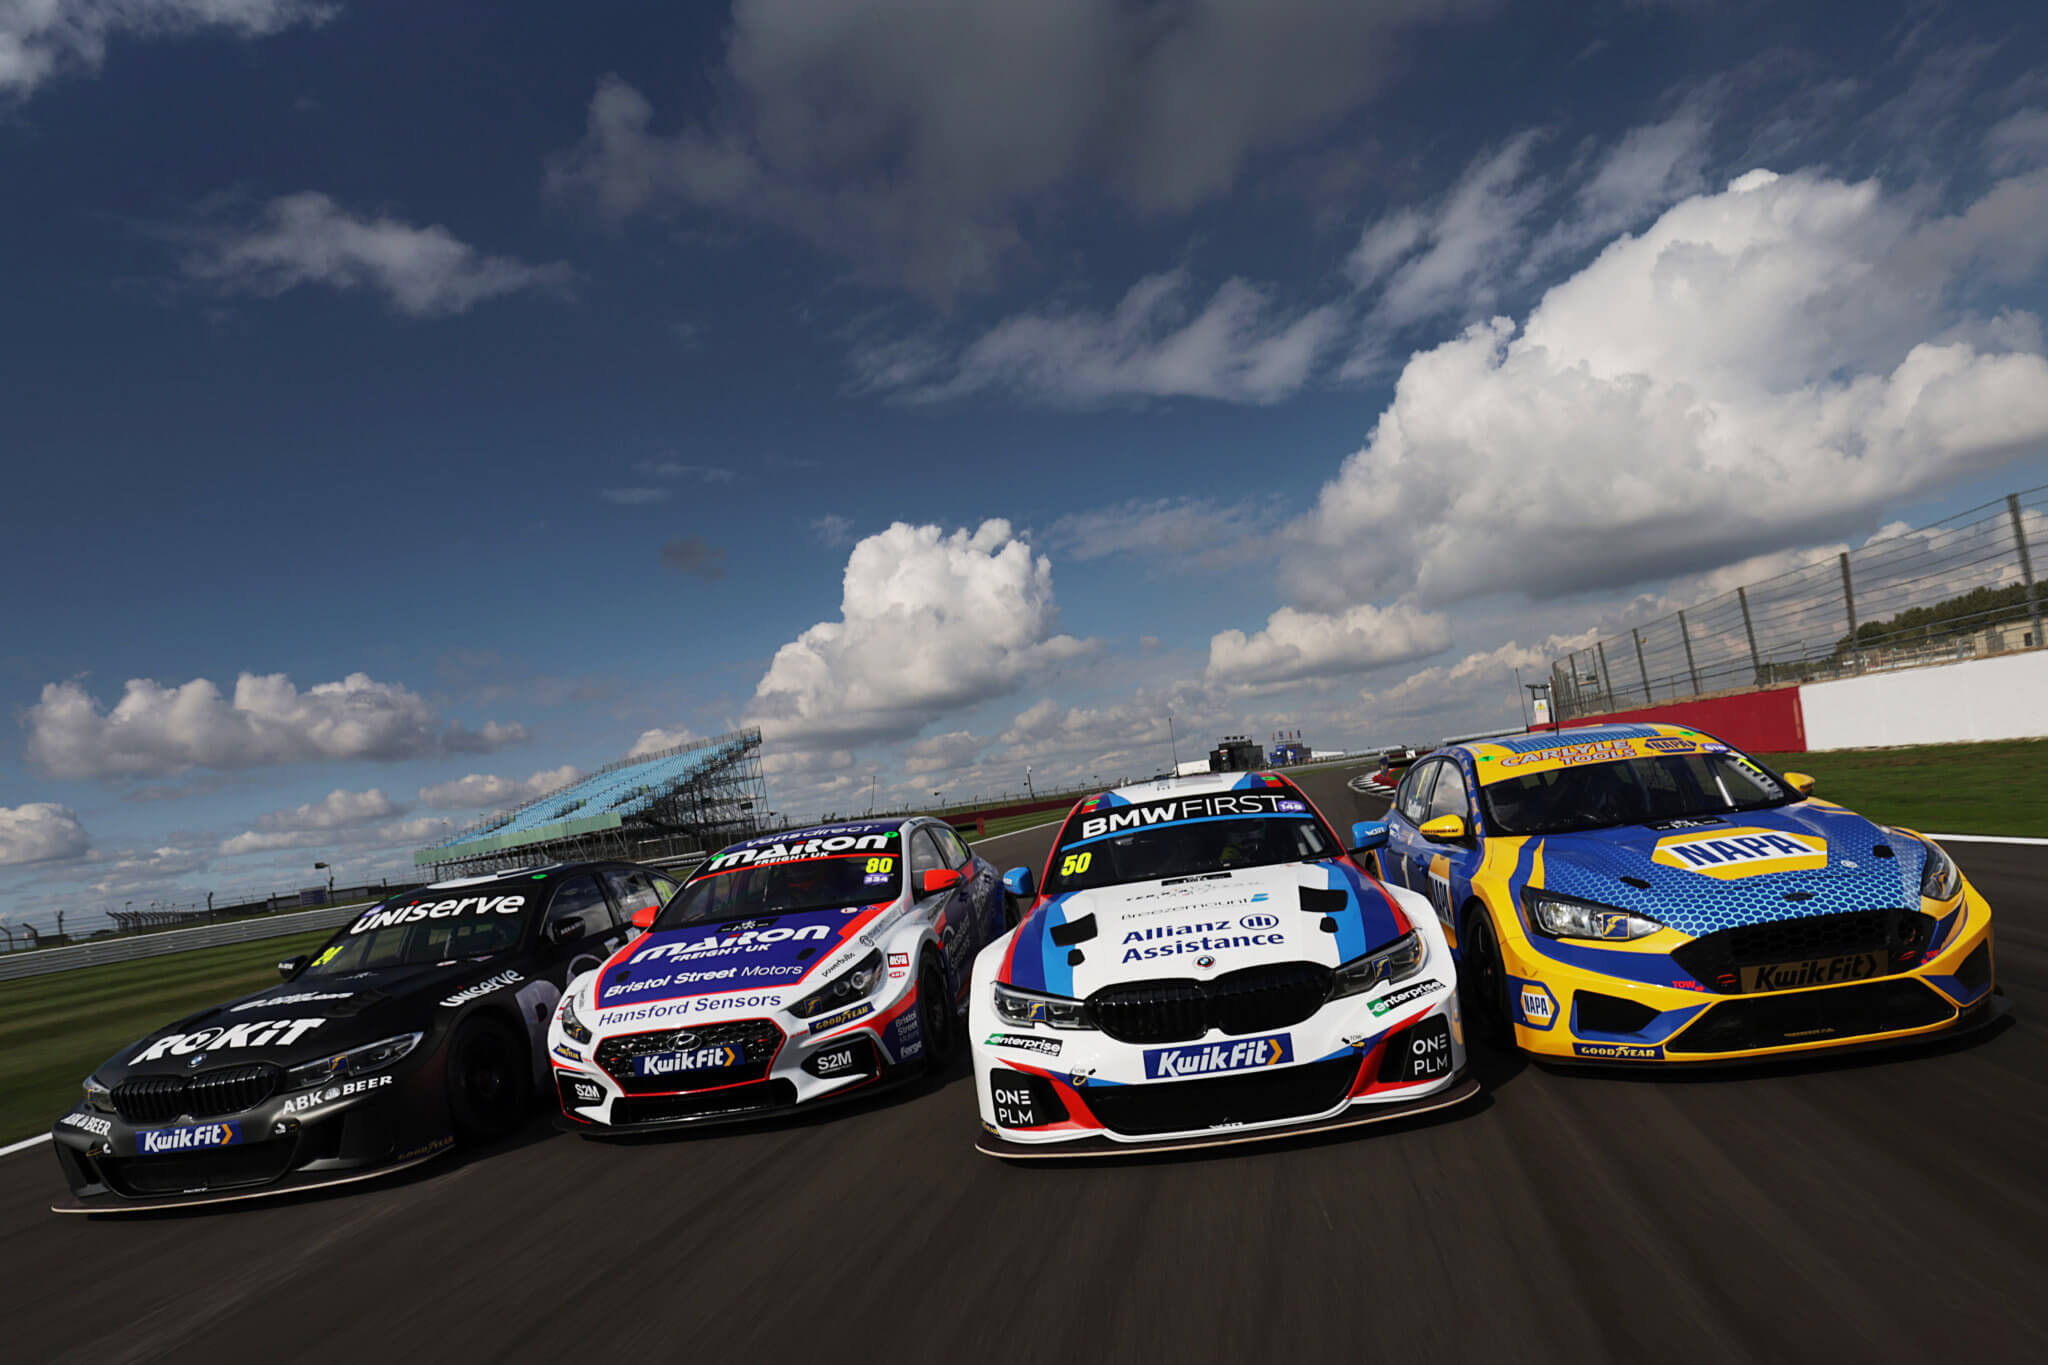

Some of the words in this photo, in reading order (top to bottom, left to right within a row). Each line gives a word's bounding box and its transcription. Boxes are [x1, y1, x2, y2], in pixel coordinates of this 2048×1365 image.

[1501, 740, 1632, 768] CARLYLE
[1650, 739, 1691, 749] NAPA
[1559, 748, 1637, 766] TOOLS
[754, 853, 807, 866] FREIGHT
[810, 850, 830, 859] UK
[1671, 834, 1813, 867] NAPA
[865, 857, 893, 874] 80
[1061, 852, 1092, 876] 50
[1121, 920, 1232, 945] Allianz
[670, 946, 744, 963] FREIGHT
[746, 943, 772, 953] UK
[1121, 933, 1285, 964] Assistance
[603, 975, 671, 999] Bristol
[673, 967, 738, 985] Street
[740, 964, 803, 978] Motors
[598, 1001, 690, 1027] Hansford
[700, 994, 782, 1013] Sensors
[1523, 994, 1550, 1016] NAPA
[815, 1004, 869, 1030] GOODYEAR
[990, 1035, 1061, 1053] enterprise
[1412, 1033, 1447, 1055] ONE
[1581, 1045, 1656, 1058] GOODYEAR
[817, 1050, 853, 1070] S2M
[1414, 1053, 1448, 1076] PLM
[282, 1090, 323, 1115] ABK
[342, 1075, 393, 1096] BEER
[574, 1084, 601, 1098] S2M
[995, 1088, 1032, 1105] ONE
[84, 1116, 112, 1136] BEER
[998, 1107, 1034, 1124] PLM
